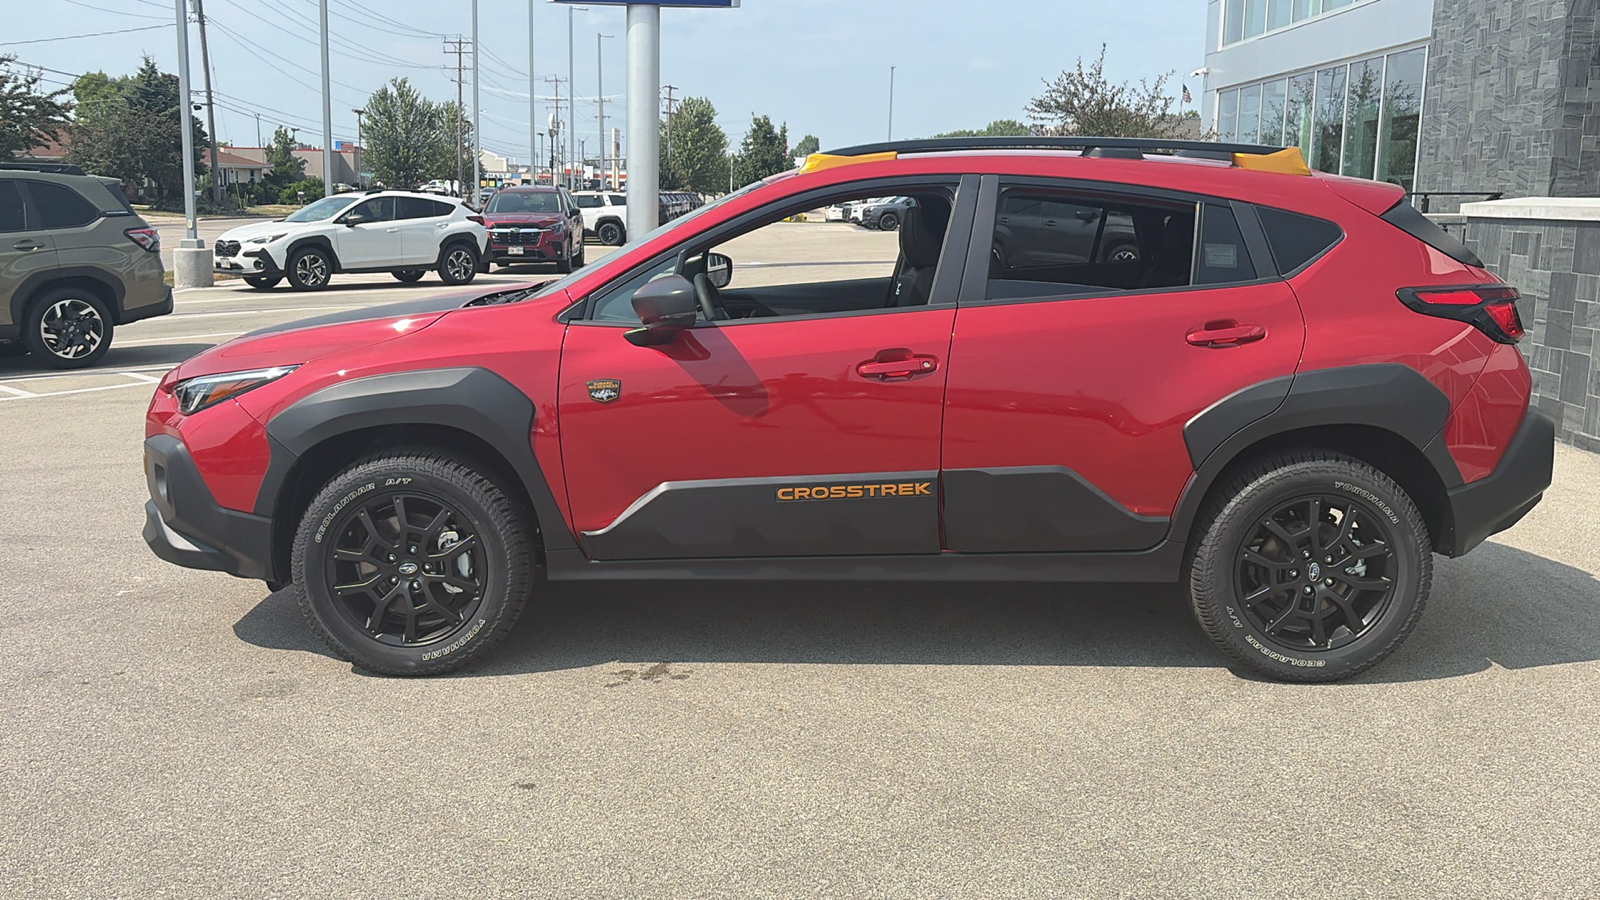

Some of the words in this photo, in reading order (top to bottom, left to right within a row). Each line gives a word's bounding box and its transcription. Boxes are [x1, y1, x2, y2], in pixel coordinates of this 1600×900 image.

[314, 482, 376, 543] GEOLANDAR
[385, 477, 412, 486] A/T
[777, 482, 931, 500] CROSSTREK
[1334, 481, 1400, 525] YOKOHAMA
[422, 618, 486, 661] YOKOHAMA
[1245, 634, 1326, 667] GEOLANDAR
